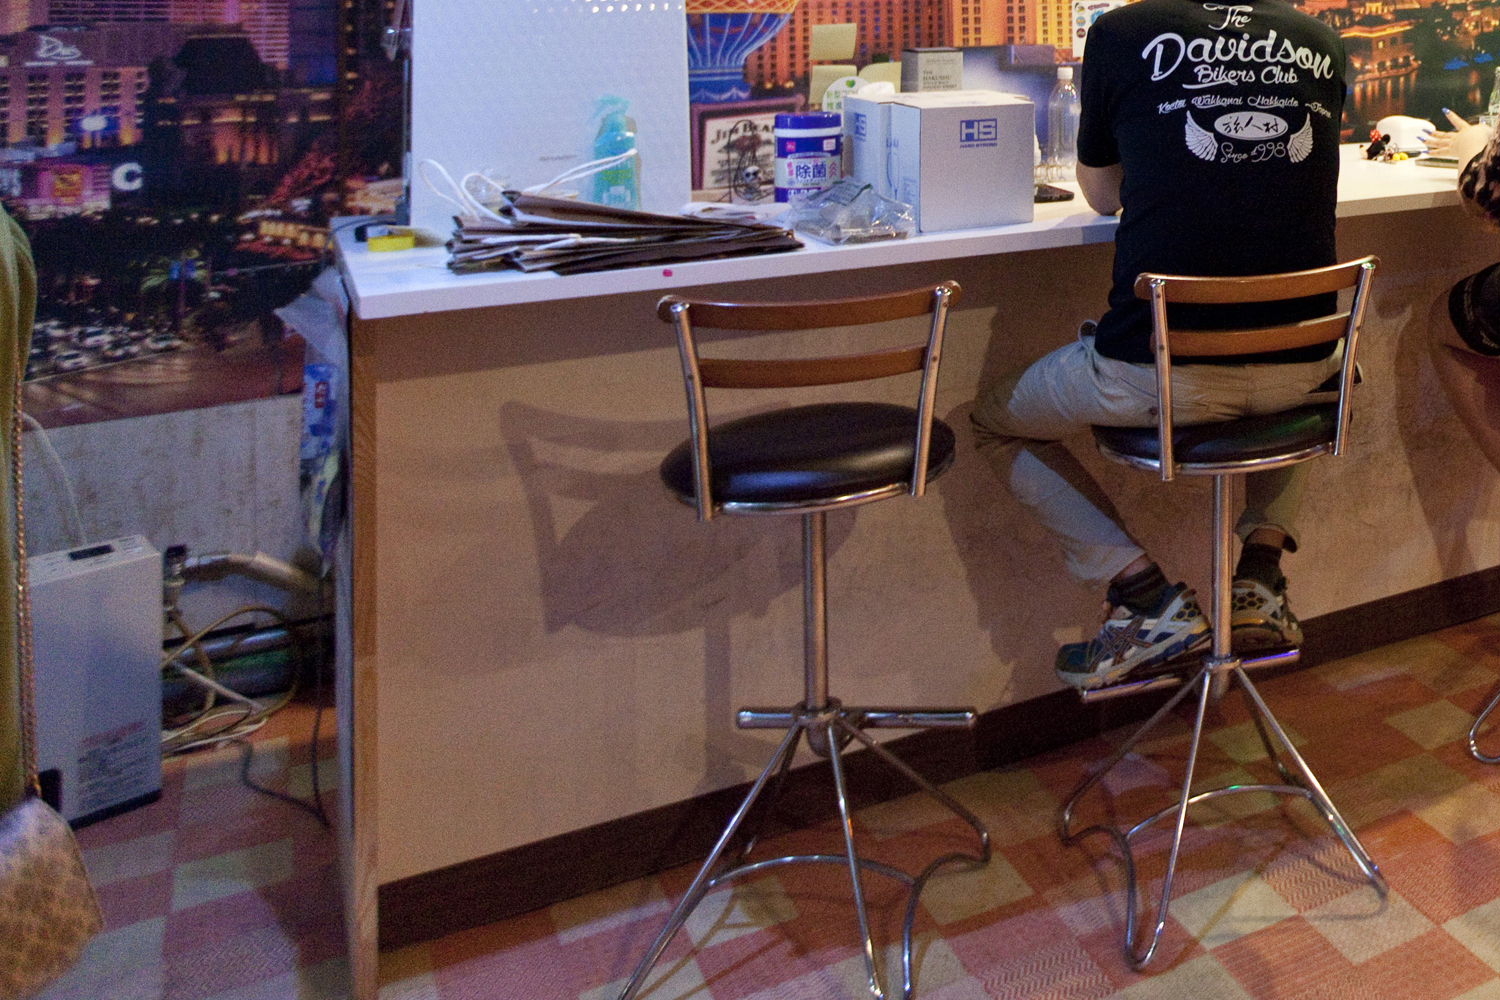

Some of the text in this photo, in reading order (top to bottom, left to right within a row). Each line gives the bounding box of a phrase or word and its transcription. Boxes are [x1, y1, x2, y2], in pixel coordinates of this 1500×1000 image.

[1203, 3, 1253, 30] The
[1142, 29, 1334, 82] Davidson
[1182, 64, 1299, 89] Bikers Club
[1191, 94, 1244, 109] Wakkanai
[960, 118, 998, 143] HS
[1251, 142, 1286, 163] 1998
[796, 162, 826, 179] 除菌
